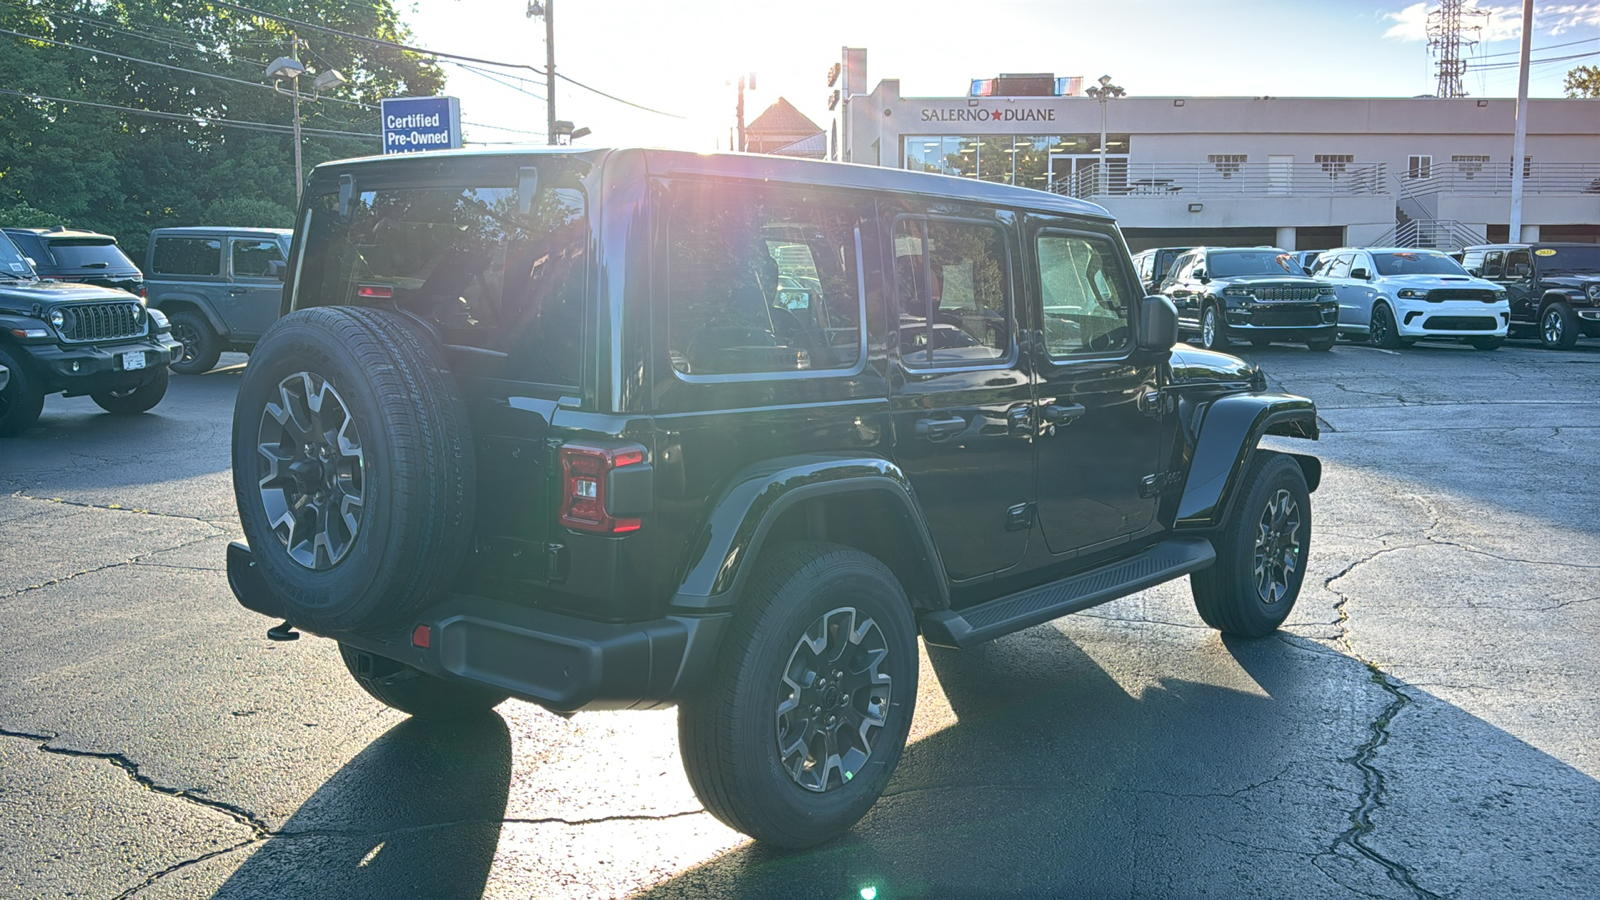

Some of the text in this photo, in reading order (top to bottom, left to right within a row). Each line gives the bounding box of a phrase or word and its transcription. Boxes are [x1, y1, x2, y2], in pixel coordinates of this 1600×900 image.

[387, 113, 440, 129] Certified
[921, 108, 1056, 122] SALERNO DUANE
[388, 130, 449, 146] Pre-Owned
